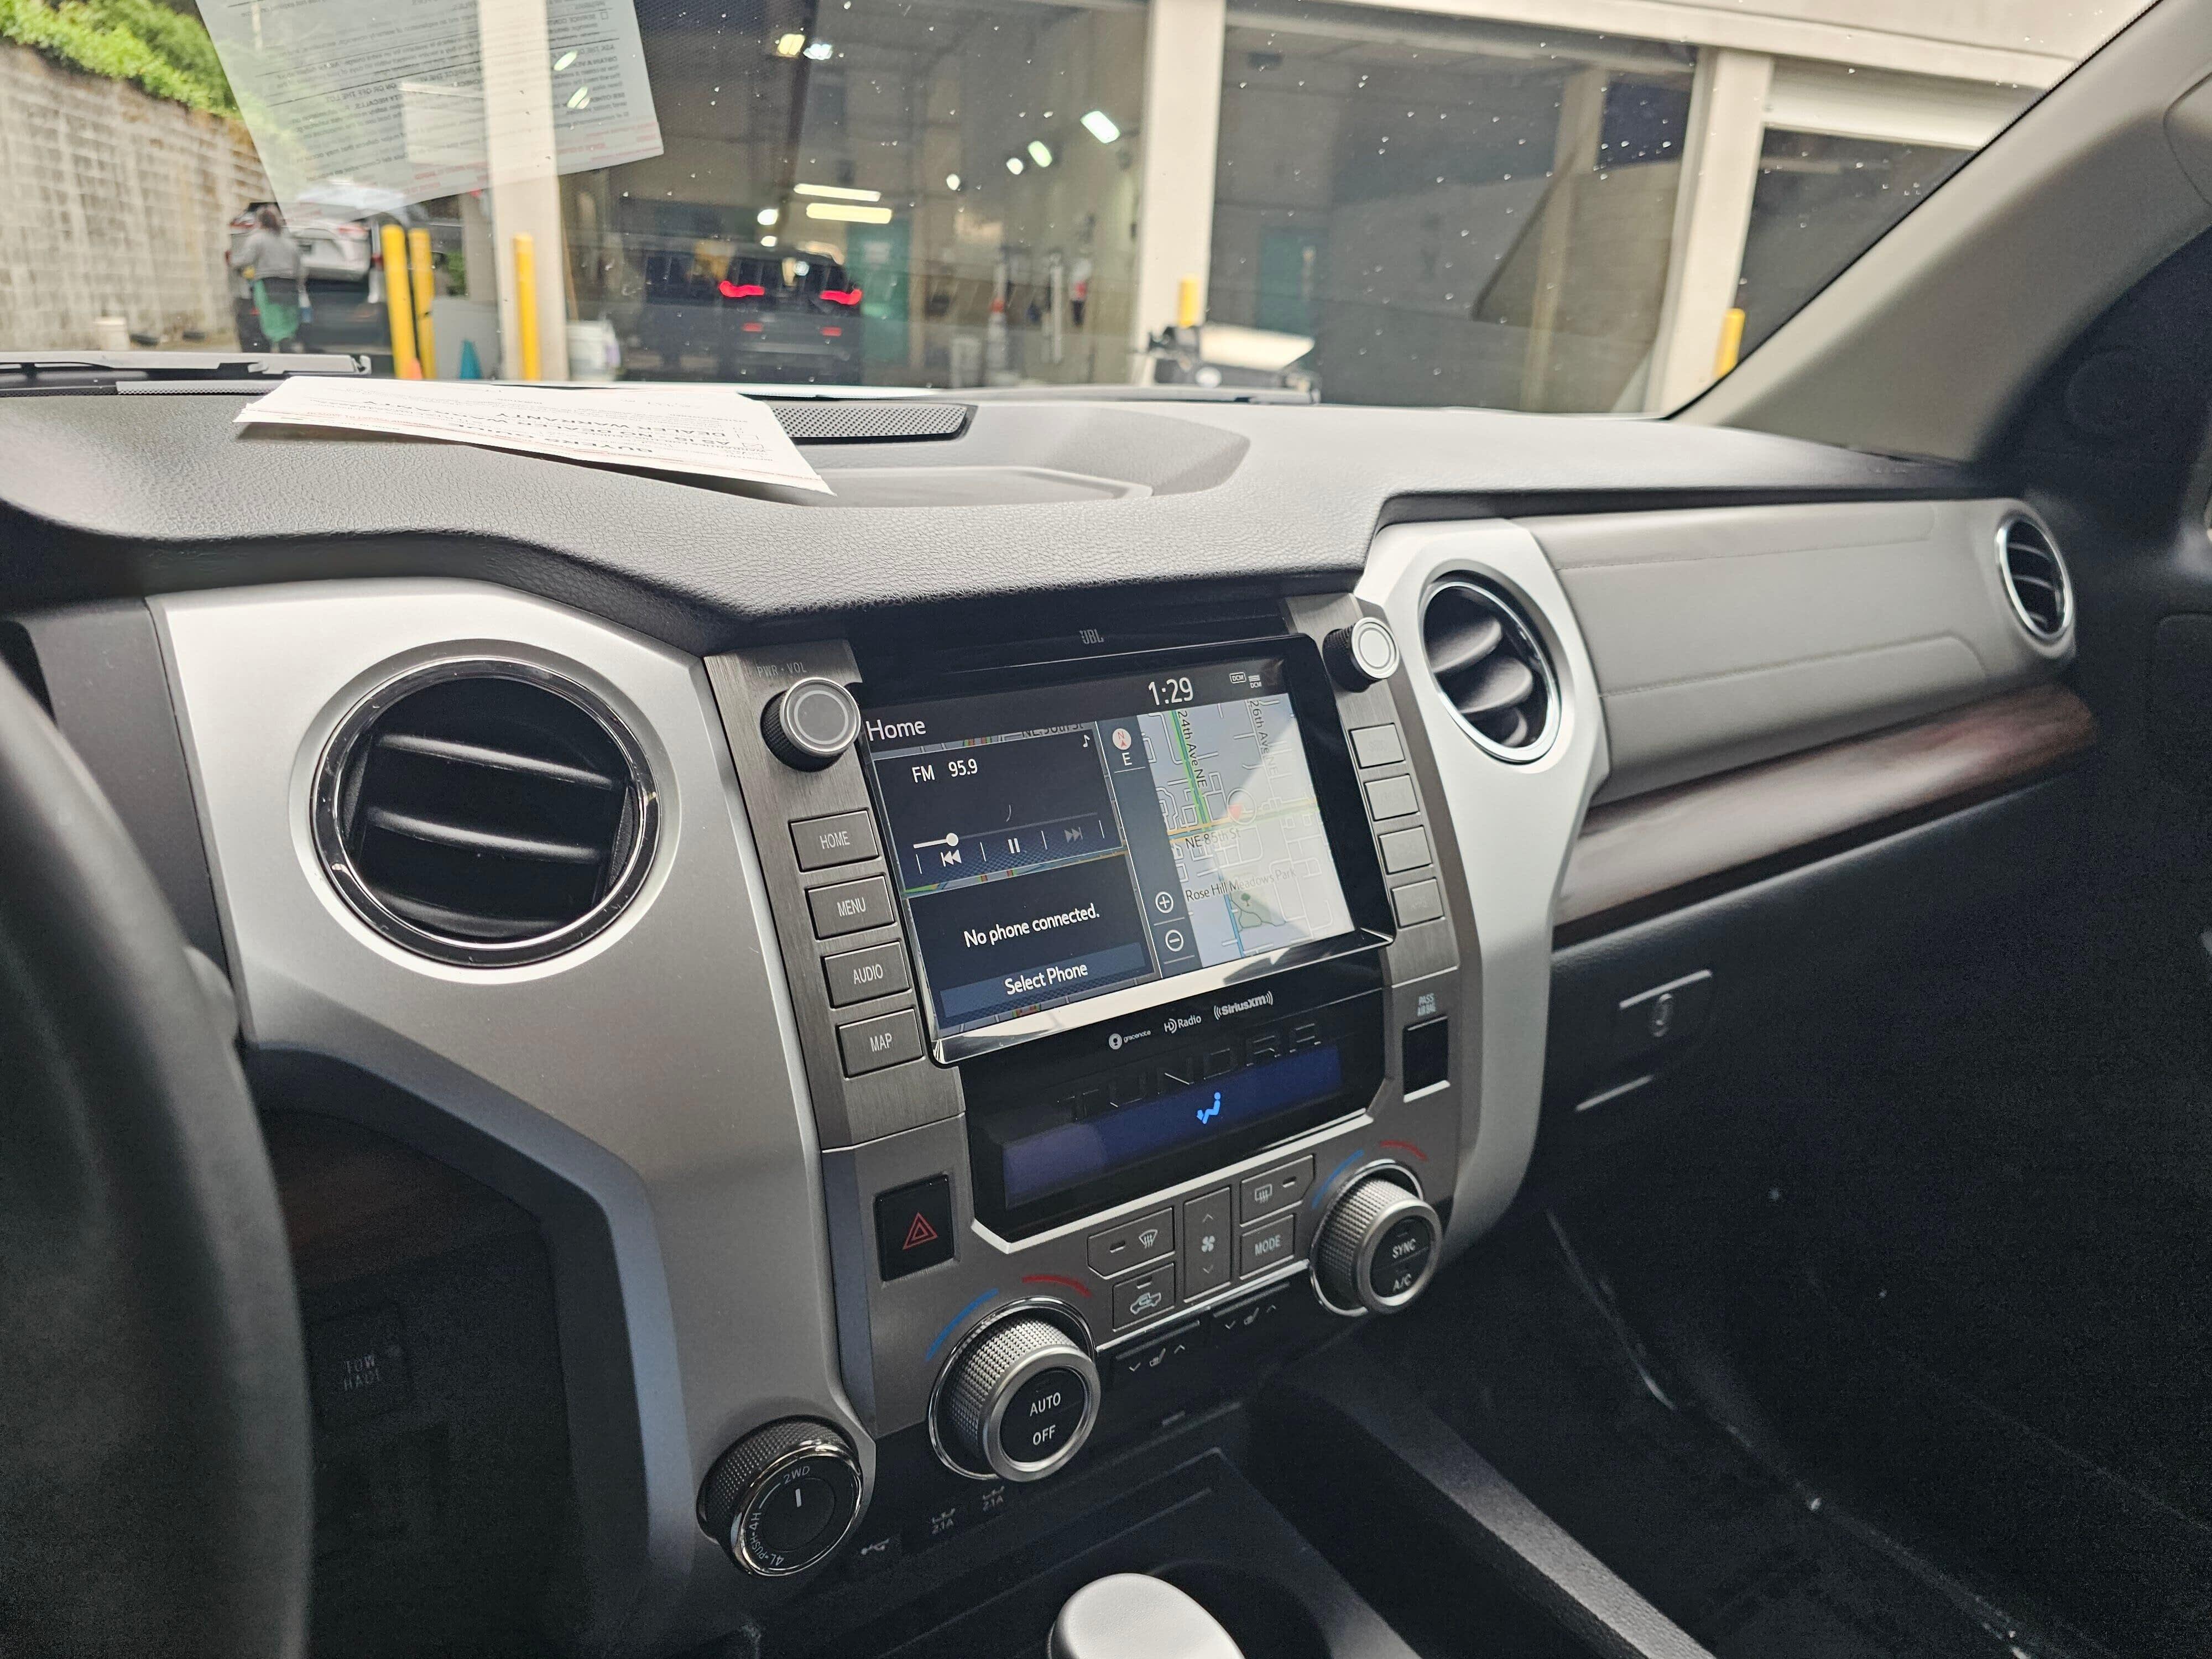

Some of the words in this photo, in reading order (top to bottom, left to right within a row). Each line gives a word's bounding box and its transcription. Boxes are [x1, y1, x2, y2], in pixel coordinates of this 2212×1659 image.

[1080, 629, 1104, 644] JBL
[757, 665, 778, 677] PWR
[788, 662, 807, 673] VOL
[1149, 677, 1193, 705] 1:29
[866, 719, 926, 741] Home
[1250, 700, 1263, 728] 26th
[1258, 732, 1270, 755] Ave
[1122, 752, 1132, 766] E
[1177, 710, 1191, 740] 24th
[1186, 744, 1198, 766] Ave
[1194, 768, 1208, 788] NE
[912, 765, 935, 782] FM
[948, 758, 978, 778] 95.9
[820, 831, 851, 849] HOME
[1185, 836, 1201, 849] NE
[1204, 831, 1229, 846] 85th
[1186, 889, 1210, 902] Rose
[1211, 881, 1228, 896] Hill
[1229, 874, 1275, 891] Meadows
[1275, 868, 1296, 880] Park
[837, 897, 867, 917] MENU
[964, 930, 987, 948] No
[989, 920, 1030, 945] phone
[1032, 902, 1100, 932] connected.
[854, 964, 883, 984] AUDIO
[1005, 972, 1046, 995] Select
[1046, 963, 1088, 985] Phone
[1178, 1015, 1202, 1029] Radio
[870, 1033, 892, 1052] MAP
[1255, 1234, 1281, 1256] MODE
[1392, 1238, 1416, 1259] SYNC
[1393, 1272, 1412, 1291] A/C
[1030, 1392, 1061, 1417] AUTO
[1032, 1425, 1056, 1446] OFF
[784, 1466, 810, 1484] 2WD
